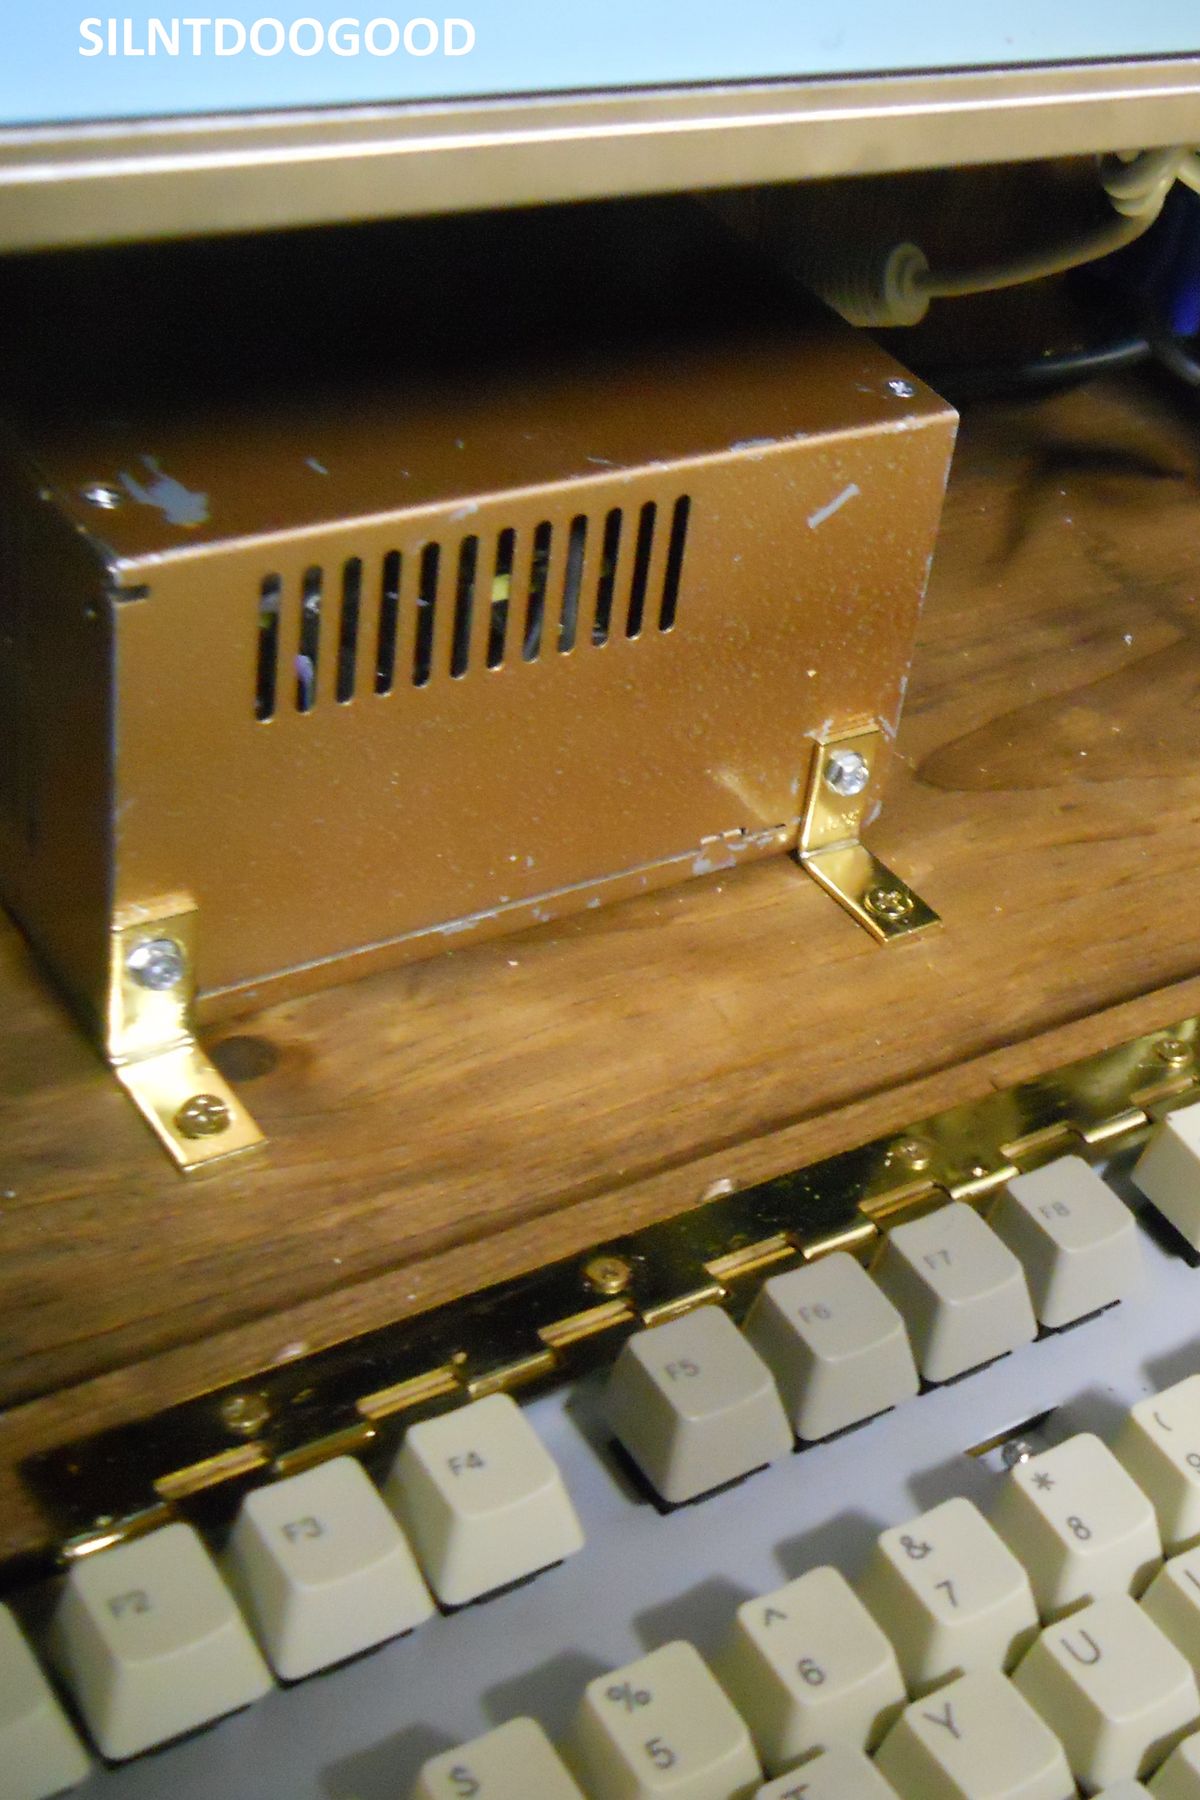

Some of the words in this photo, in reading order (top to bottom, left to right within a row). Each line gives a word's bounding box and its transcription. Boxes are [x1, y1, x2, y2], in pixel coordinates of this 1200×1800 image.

[1037, 1200, 1070, 1220] F8
[923, 1250, 952, 1271] F7
[799, 1301, 833, 1324] F6
[664, 1357, 701, 1382] F5
[447, 1450, 485, 1477] F4
[282, 1515, 324, 1545] F3
[1066, 1515, 1094, 1541] 8
[900, 1533, 933, 1560] &
[109, 1587, 150, 1618] F2
[934, 1579, 960, 1608] 7
[1058, 1627, 1103, 1666] U
[797, 1657, 826, 1687] 6
[605, 1682, 653, 1714] %
[922, 1701, 963, 1741] Y
[644, 1735, 677, 1771] 5
